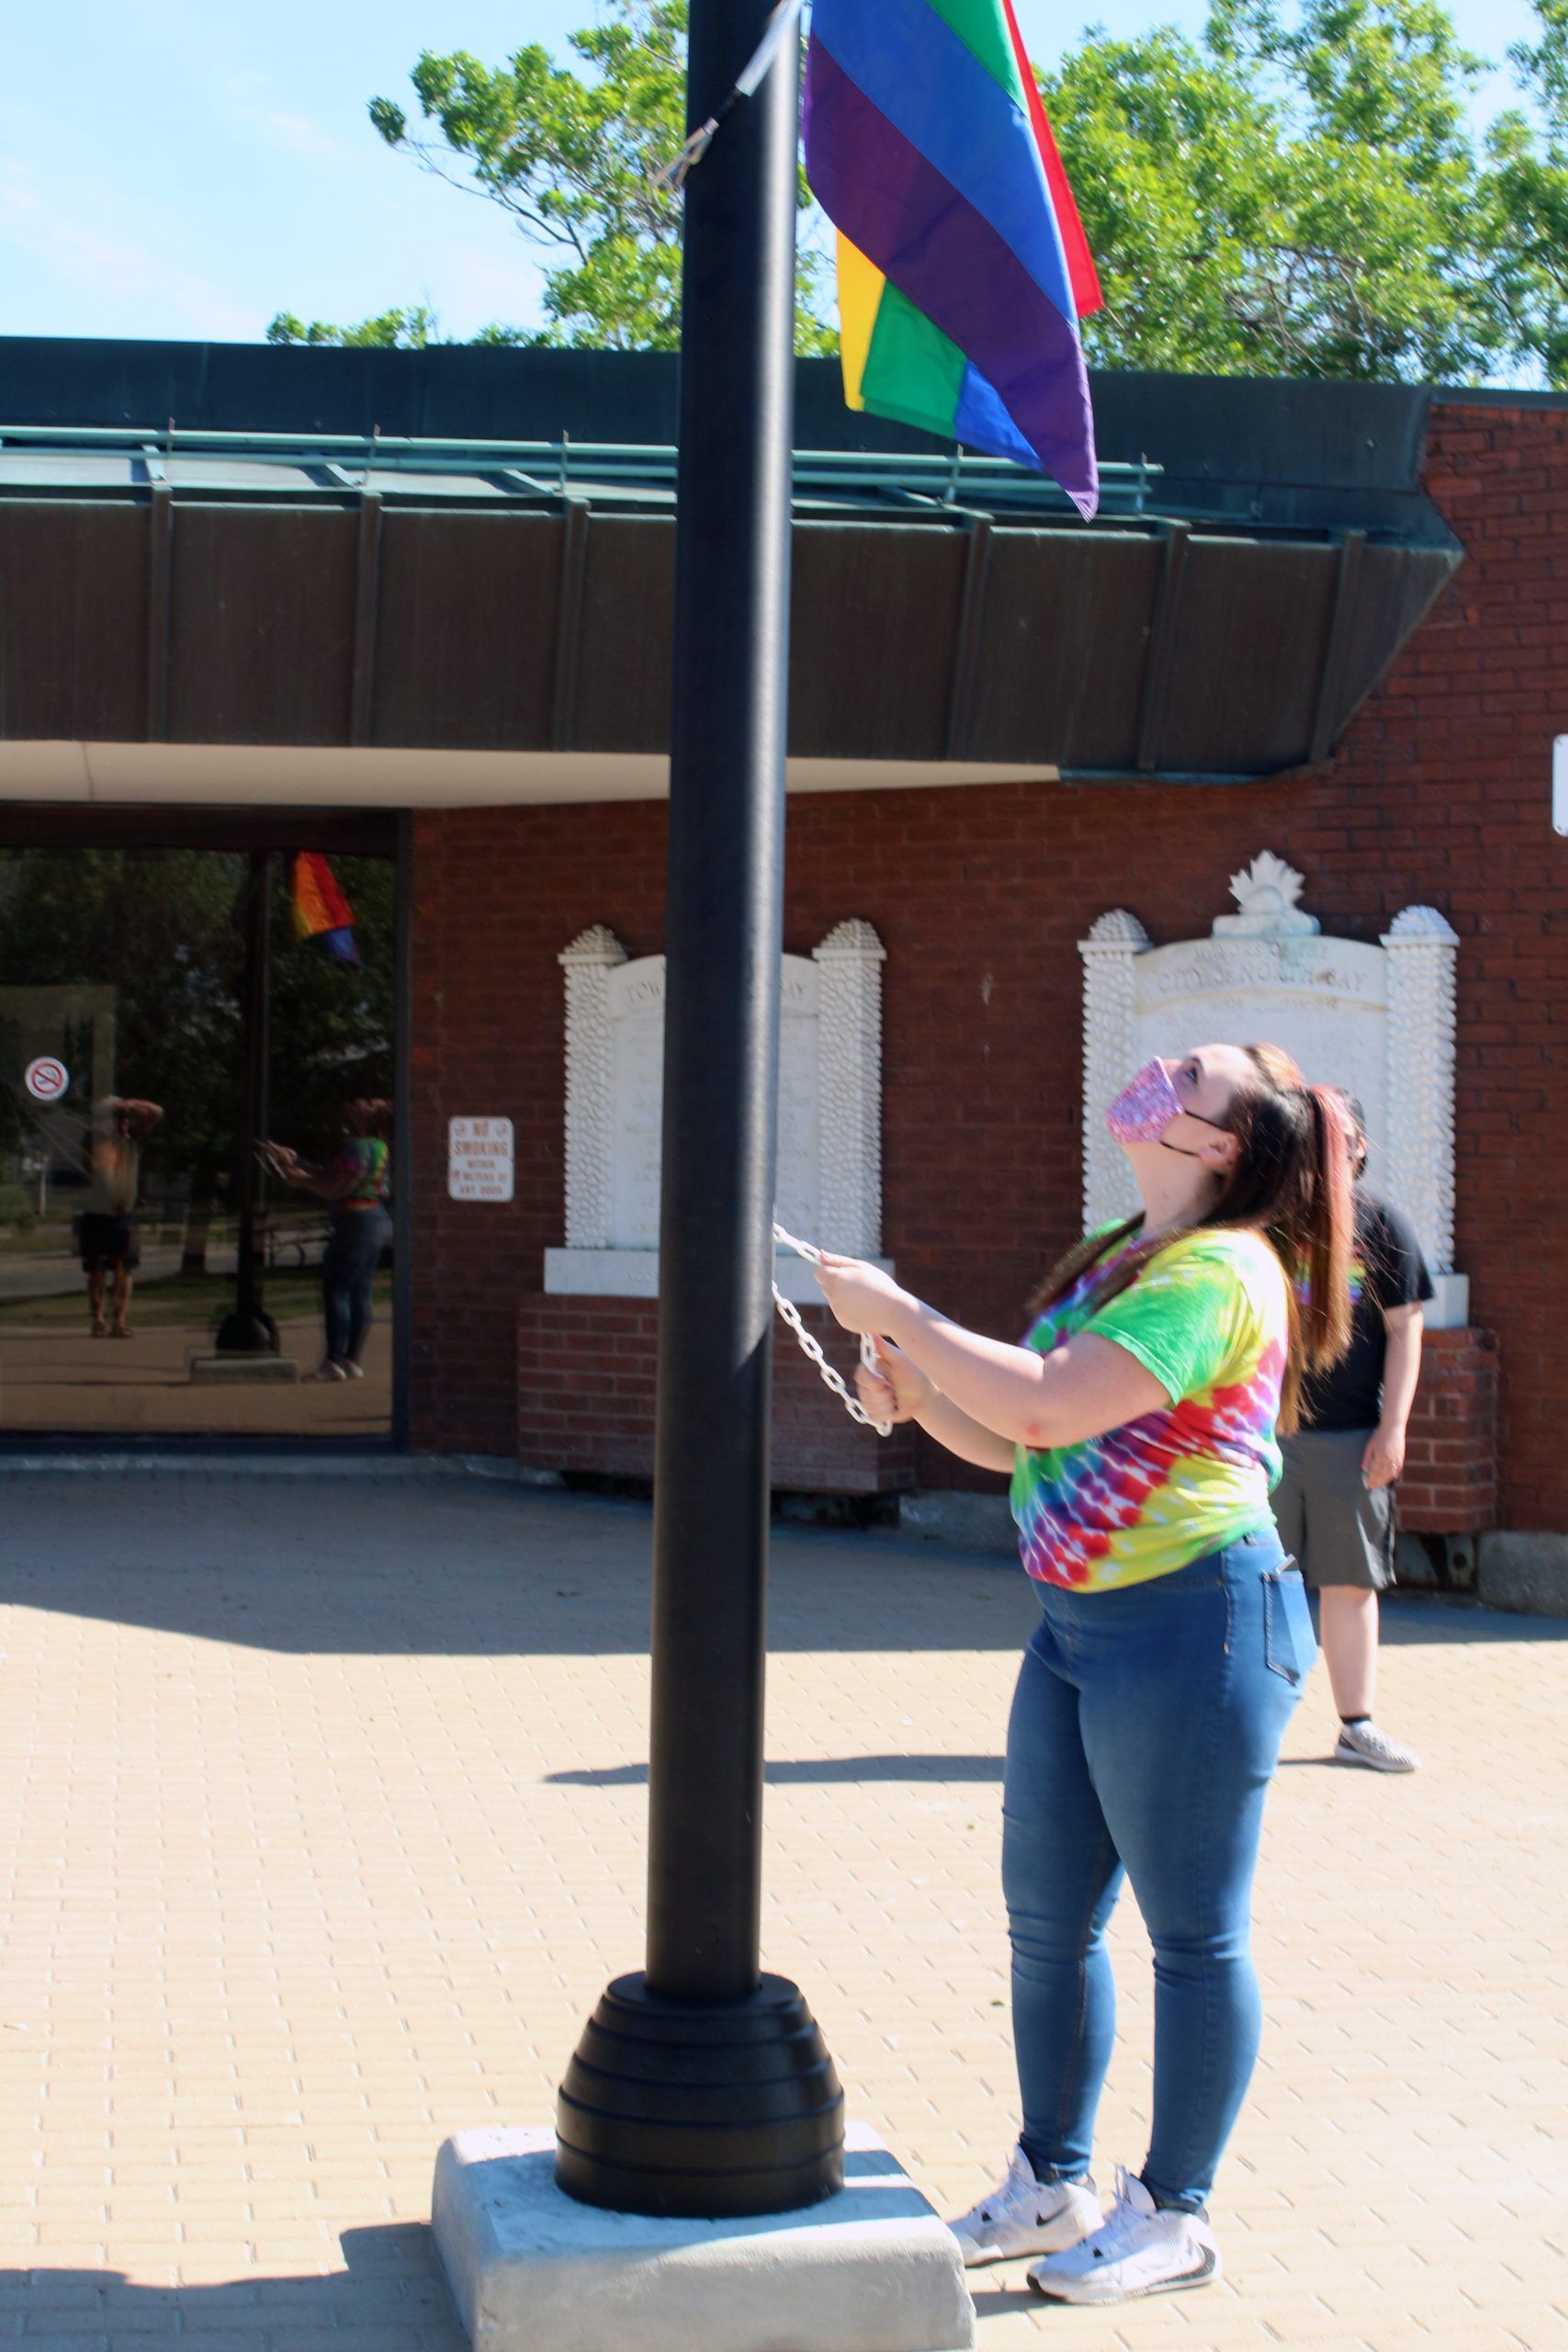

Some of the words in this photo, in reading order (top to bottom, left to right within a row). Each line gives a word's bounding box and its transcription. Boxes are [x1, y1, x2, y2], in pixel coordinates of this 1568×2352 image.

[1156, 967, 1204, 993] CITY
[1240, 961, 1314, 987] NORTH
[1325, 968, 1367, 993] BAY
[626, 976, 665, 1003] TOW
[473, 1119, 490, 1137] NO
[455, 1140, 509, 1157] SMOKING
[468, 1159, 497, 1170] WITHIN
